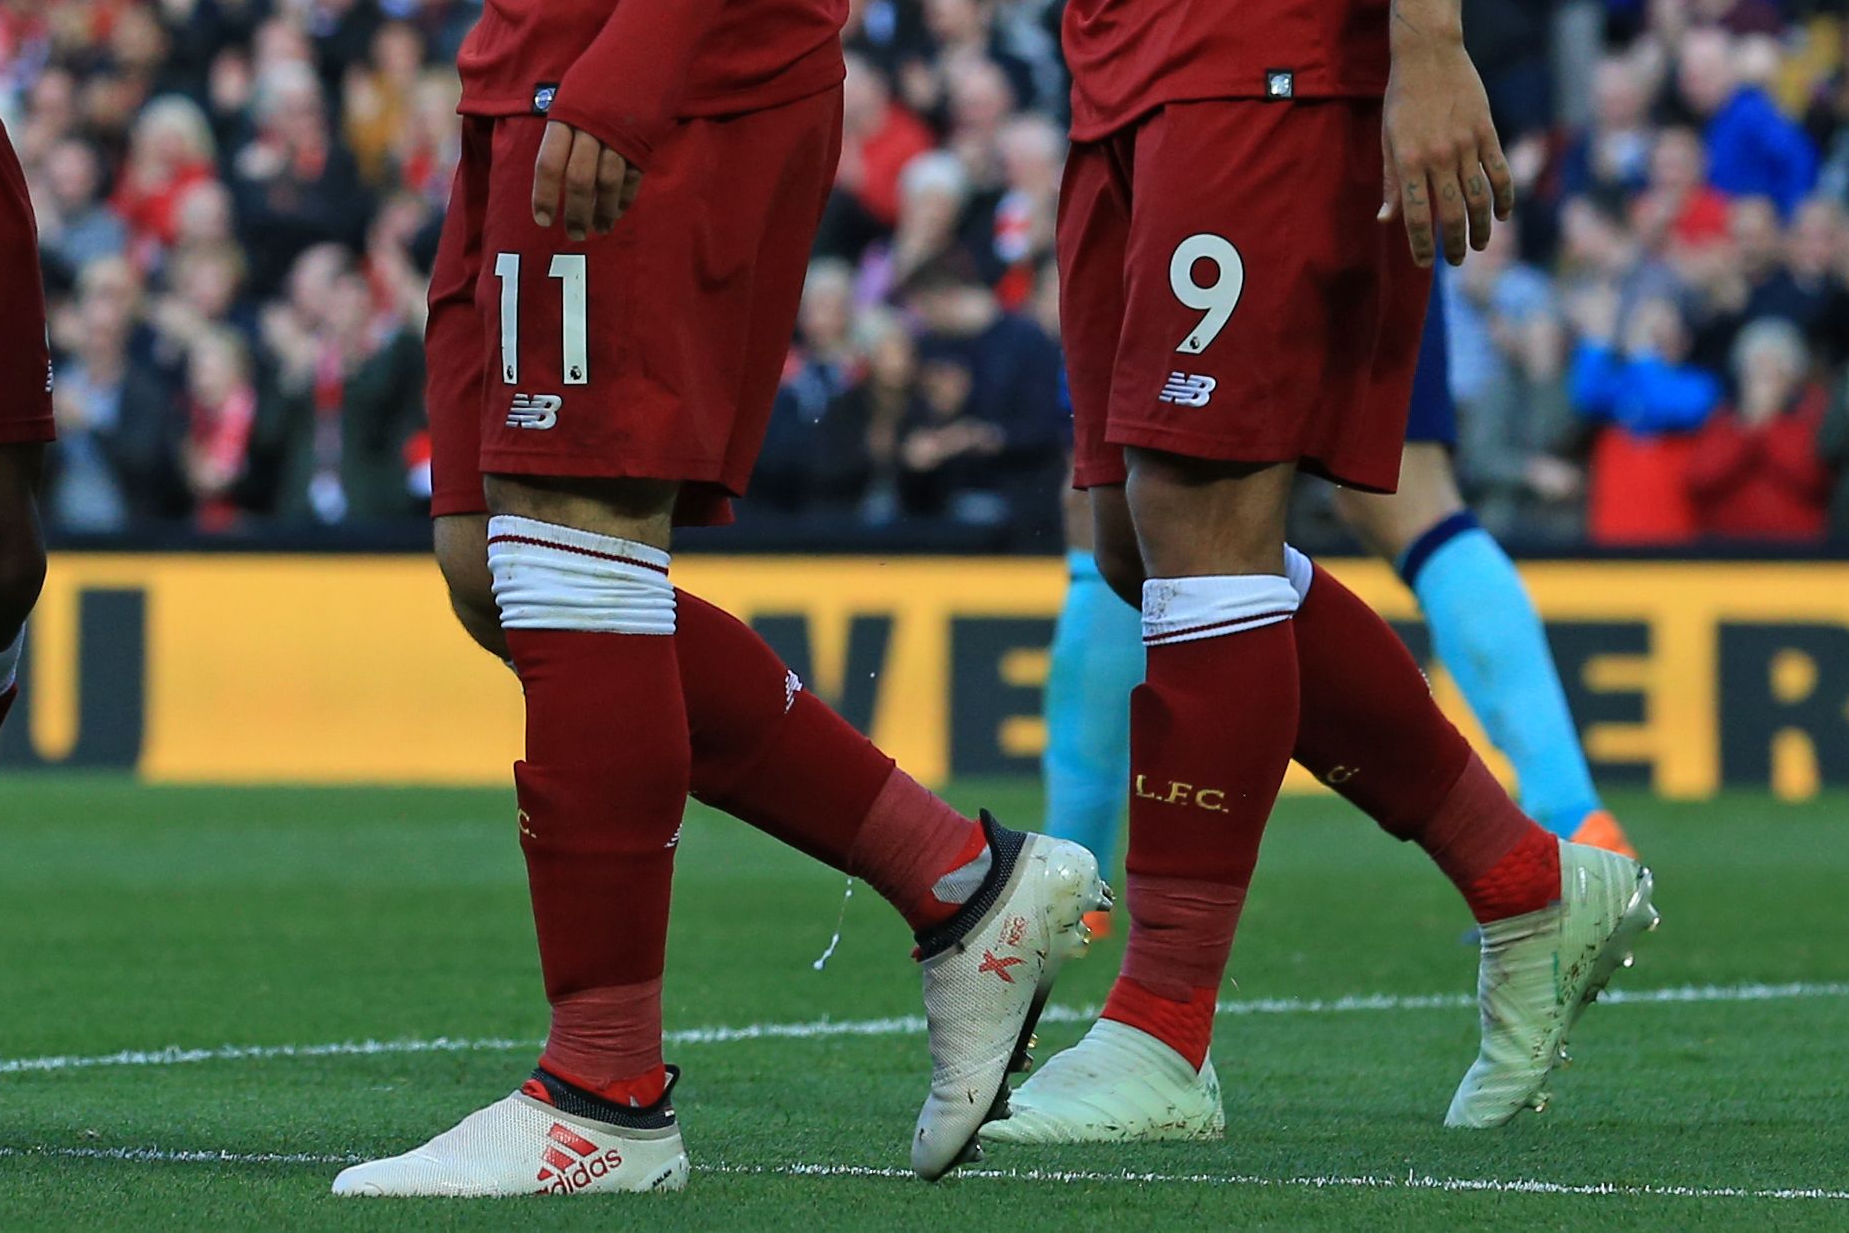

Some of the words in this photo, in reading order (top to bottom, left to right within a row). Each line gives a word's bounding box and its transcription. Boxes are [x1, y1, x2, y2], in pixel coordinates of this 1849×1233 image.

[494, 252, 588, 385] 11
[1169, 233, 1244, 355] 9
[1135, 773, 1230, 814] L.F.C.
[534, 1148, 624, 1196] didas
